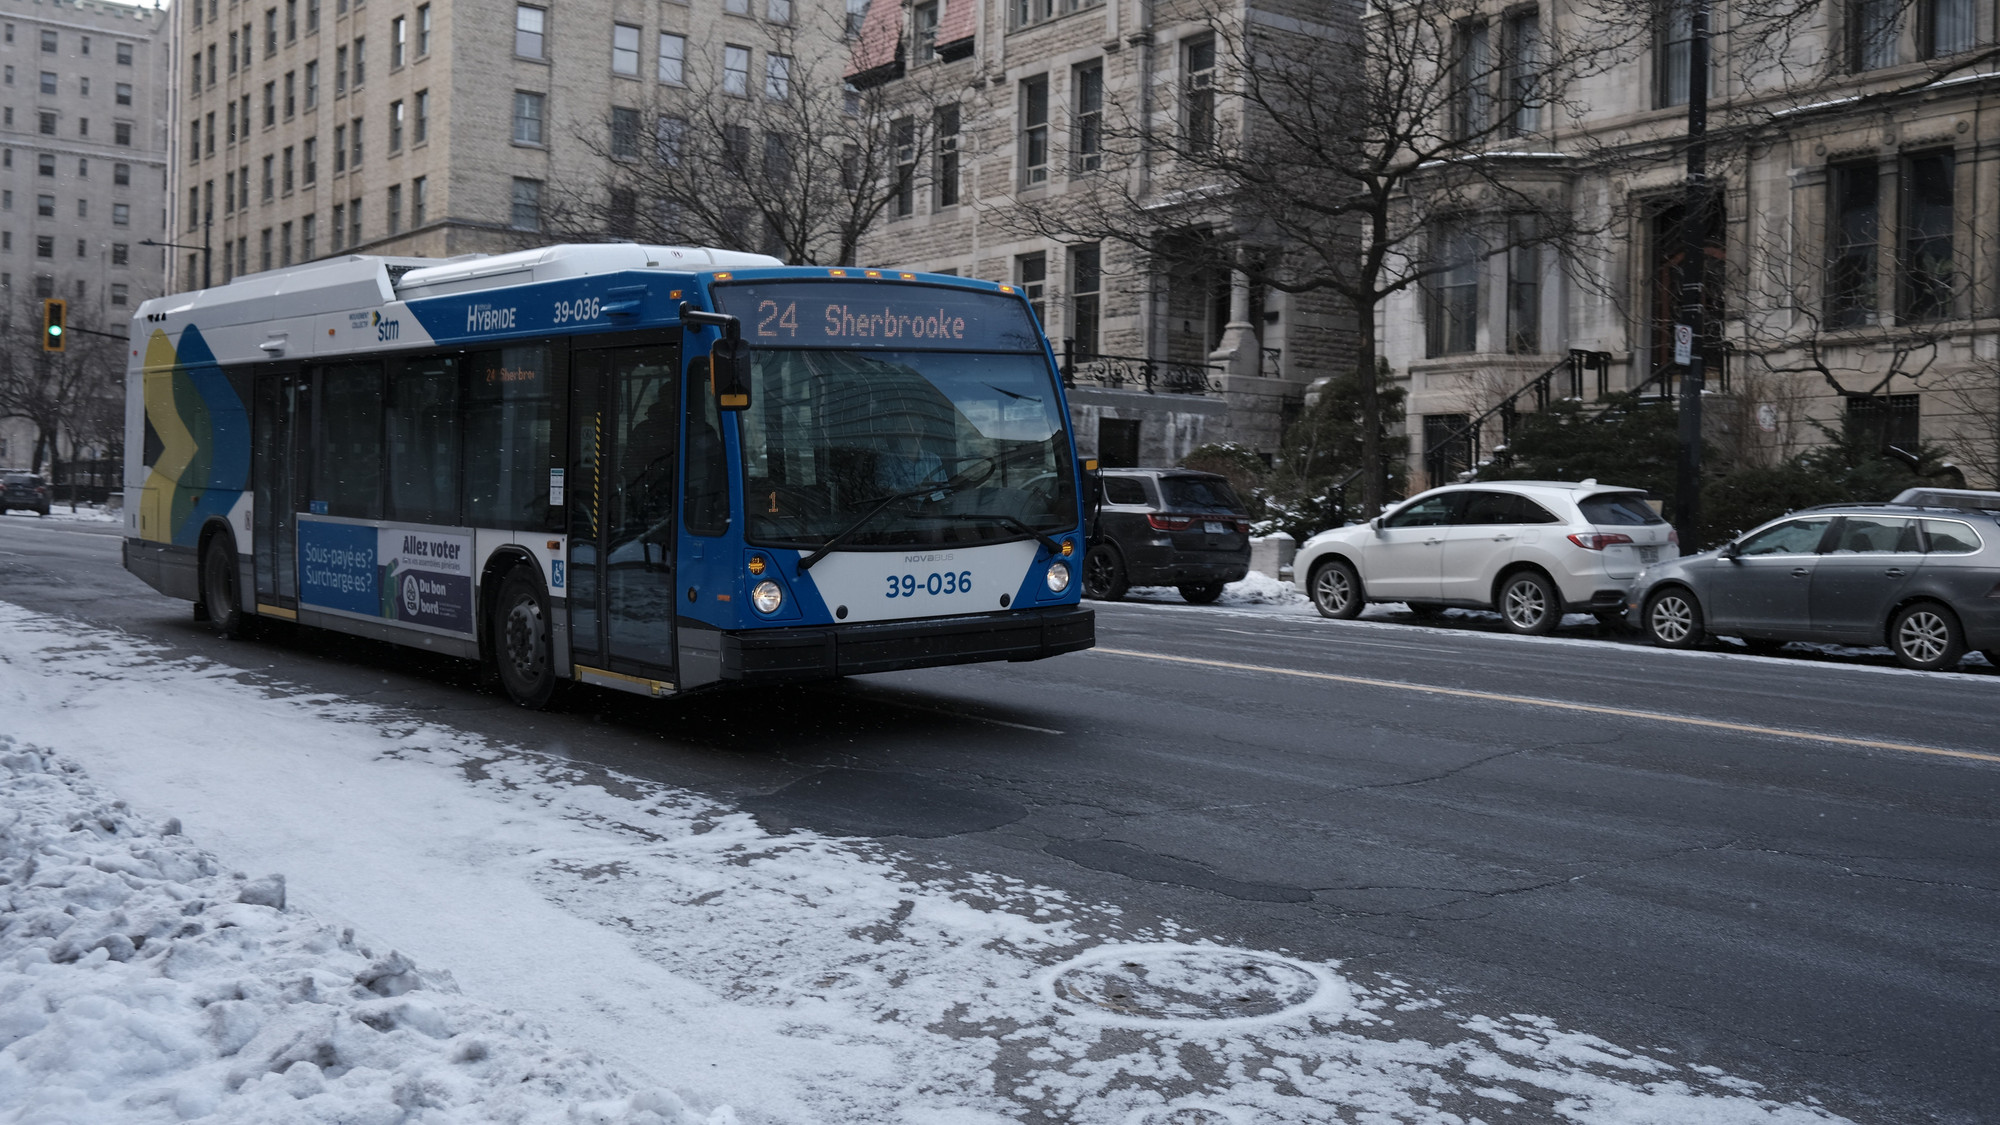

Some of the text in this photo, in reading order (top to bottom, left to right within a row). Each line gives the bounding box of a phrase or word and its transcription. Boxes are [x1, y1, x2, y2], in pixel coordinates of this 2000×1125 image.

[553, 297, 600, 323] 39-036
[758, 300, 965, 339] 24 Sherbrooke
[378, 317, 399, 341] stm
[403, 535, 460, 559] Allez voter
[420, 578, 446, 596] Du bon
[885, 570, 972, 598] 39-036
[420, 599, 439, 614] bord
